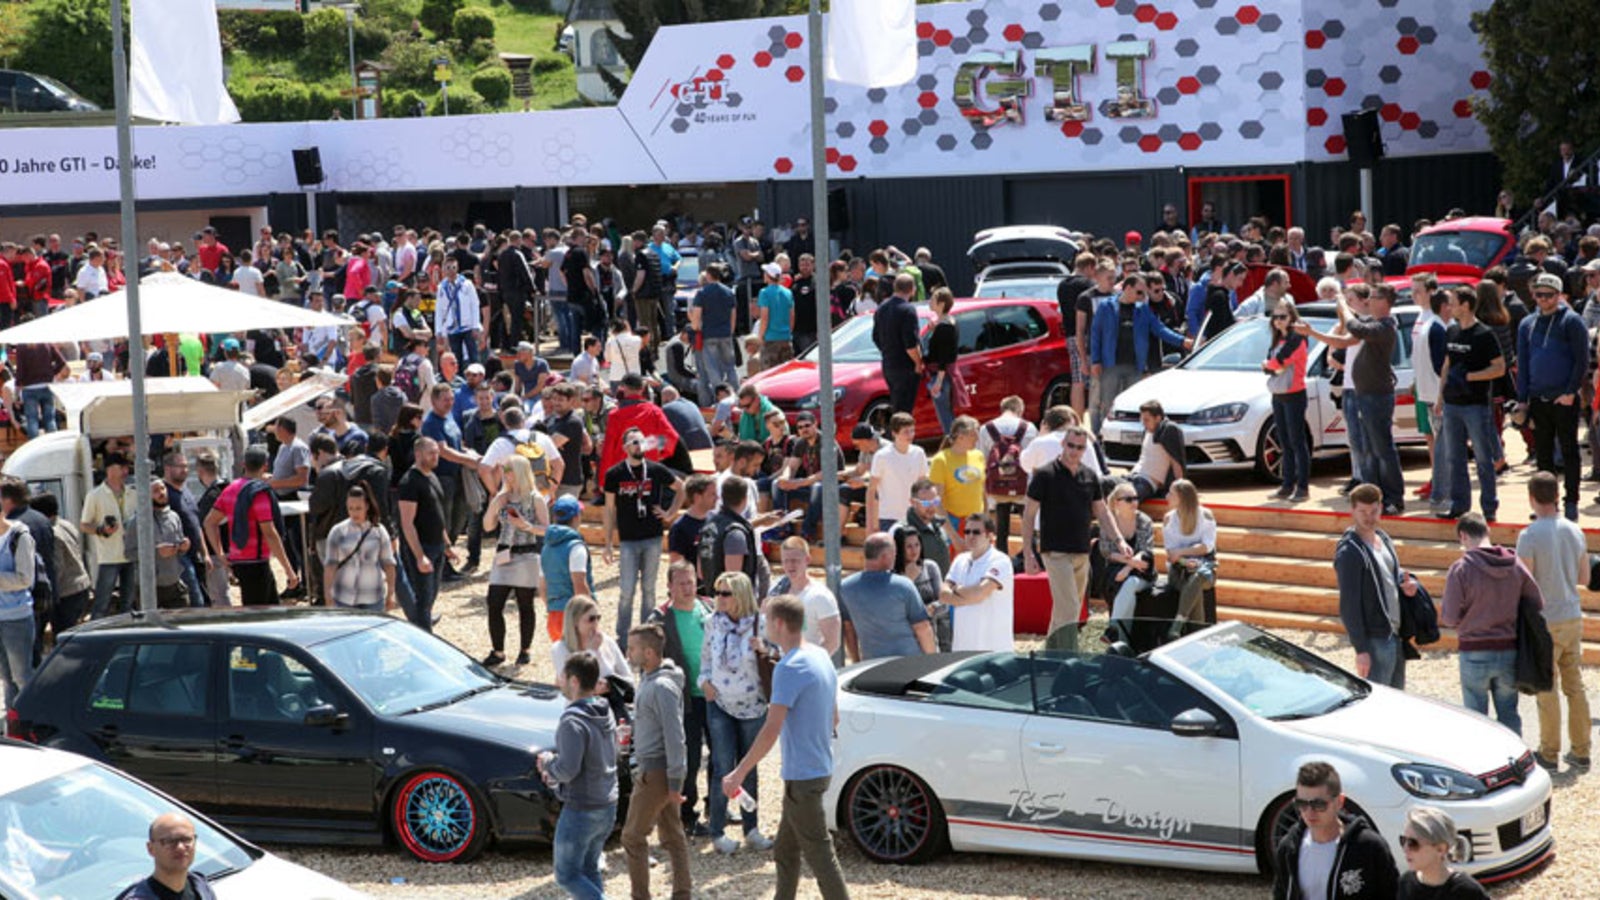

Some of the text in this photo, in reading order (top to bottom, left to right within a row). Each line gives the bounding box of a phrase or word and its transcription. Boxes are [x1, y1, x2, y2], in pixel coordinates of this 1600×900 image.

[679, 80, 730, 104] GTI
[953, 39, 1158, 127] GTI
[13, 157, 56, 173] Jahre
[60, 156, 86, 173] GTI
[104, 155, 156, 171] Dke!
[1096, 798, 1192, 840] Design
